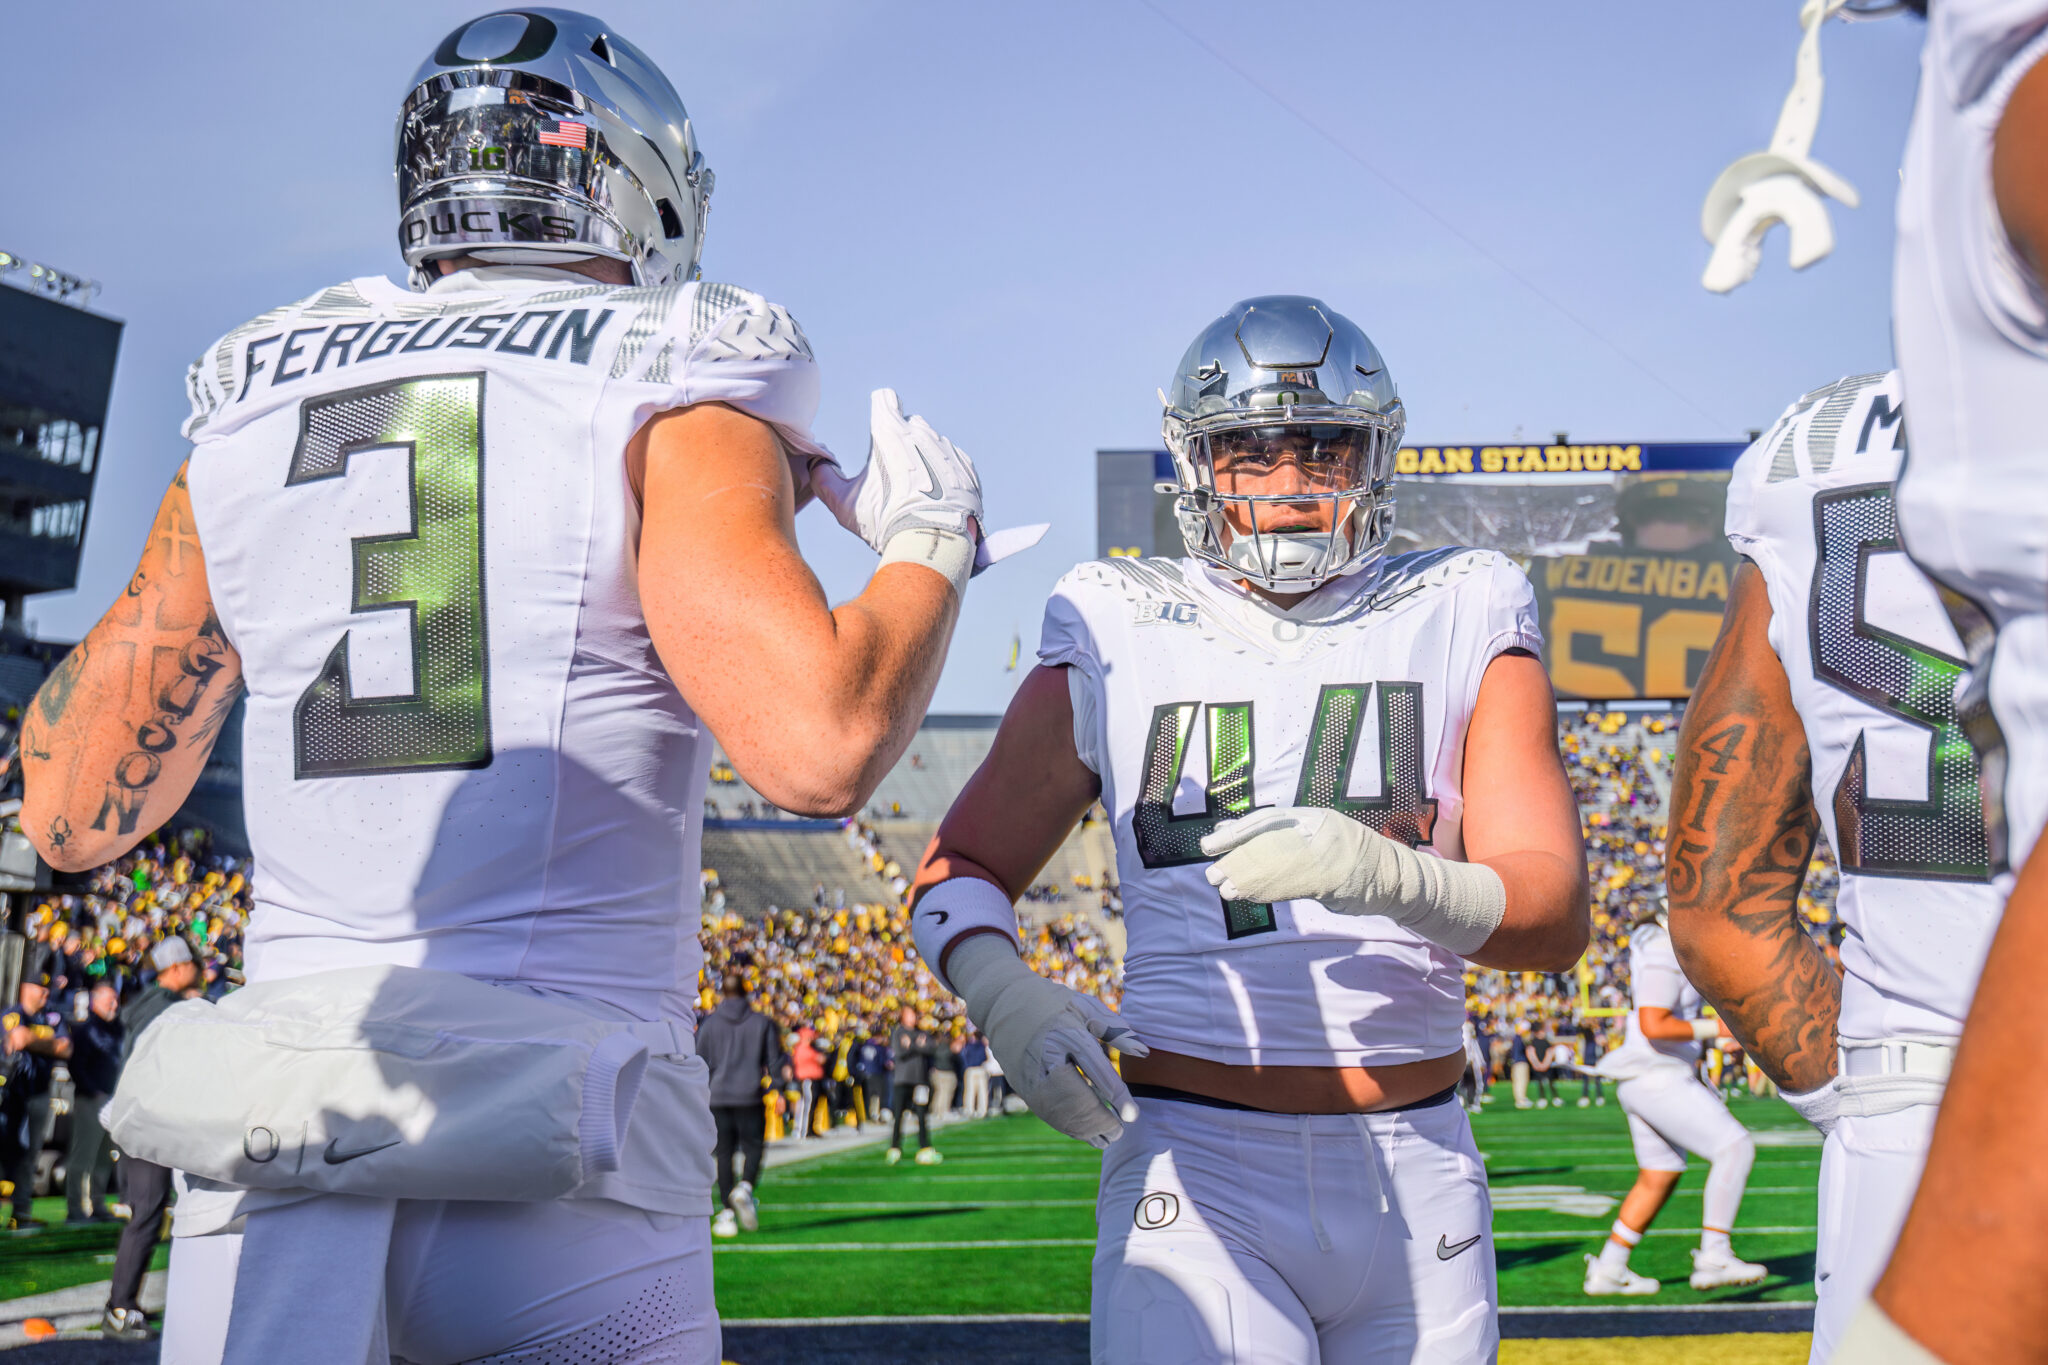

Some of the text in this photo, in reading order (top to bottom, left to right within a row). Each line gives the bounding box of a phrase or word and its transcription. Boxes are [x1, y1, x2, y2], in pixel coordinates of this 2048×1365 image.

[407, 211, 577, 245] DUCKS
[237, 308, 617, 403] FERGUSON
[1394, 445, 1642, 475] GAN STADIUM
[284, 370, 494, 781] 3
[1546, 554, 1741, 601] WEIDENBA
[1132, 680, 1439, 940] 44
